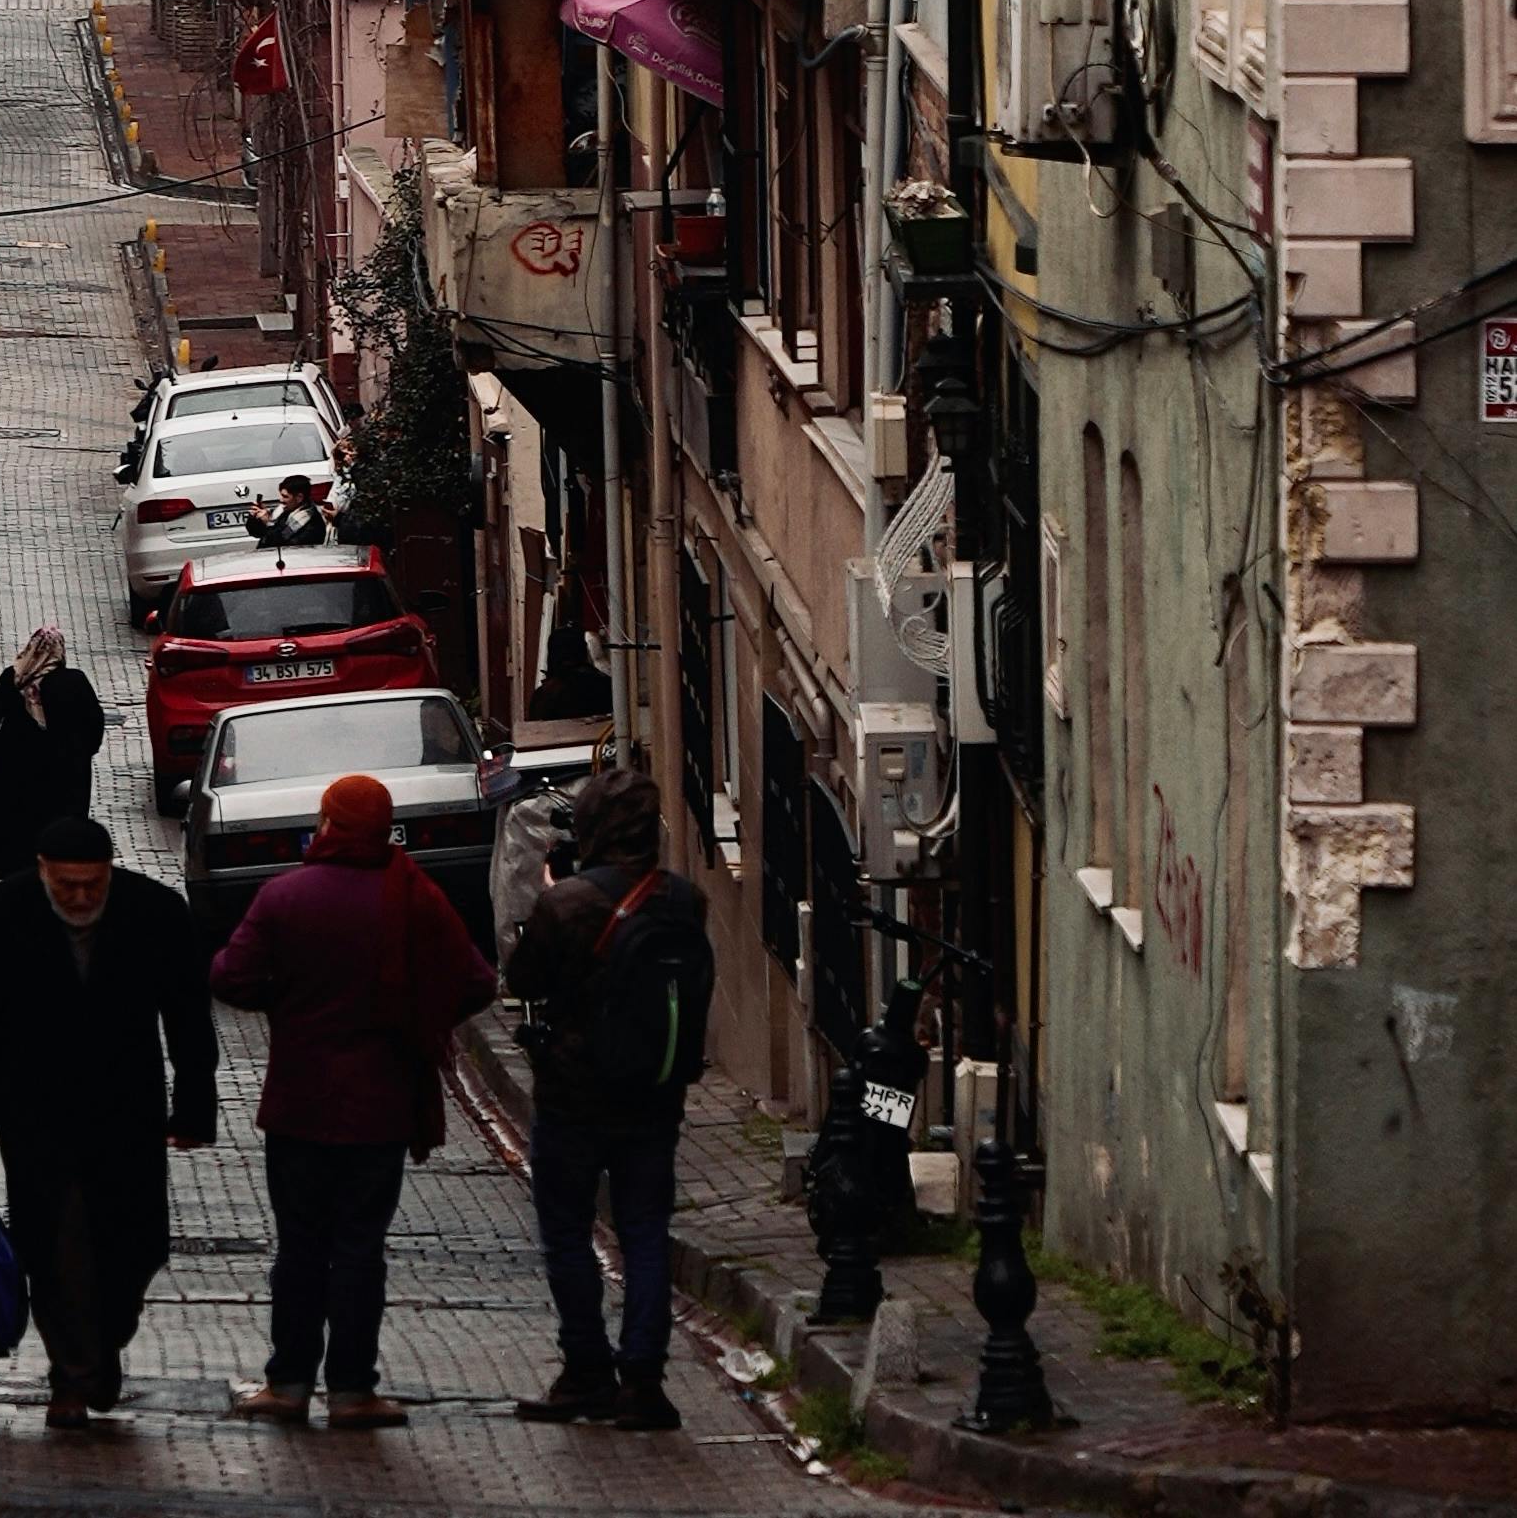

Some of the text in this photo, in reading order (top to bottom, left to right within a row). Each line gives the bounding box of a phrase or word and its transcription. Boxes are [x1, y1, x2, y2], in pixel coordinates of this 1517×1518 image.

[1486, 357, 1517, 375] HA
[1500, 376, 1517, 402] 5
[214, 512, 230, 525] 34
[254, 661, 332, 680] 34 BSV 575
